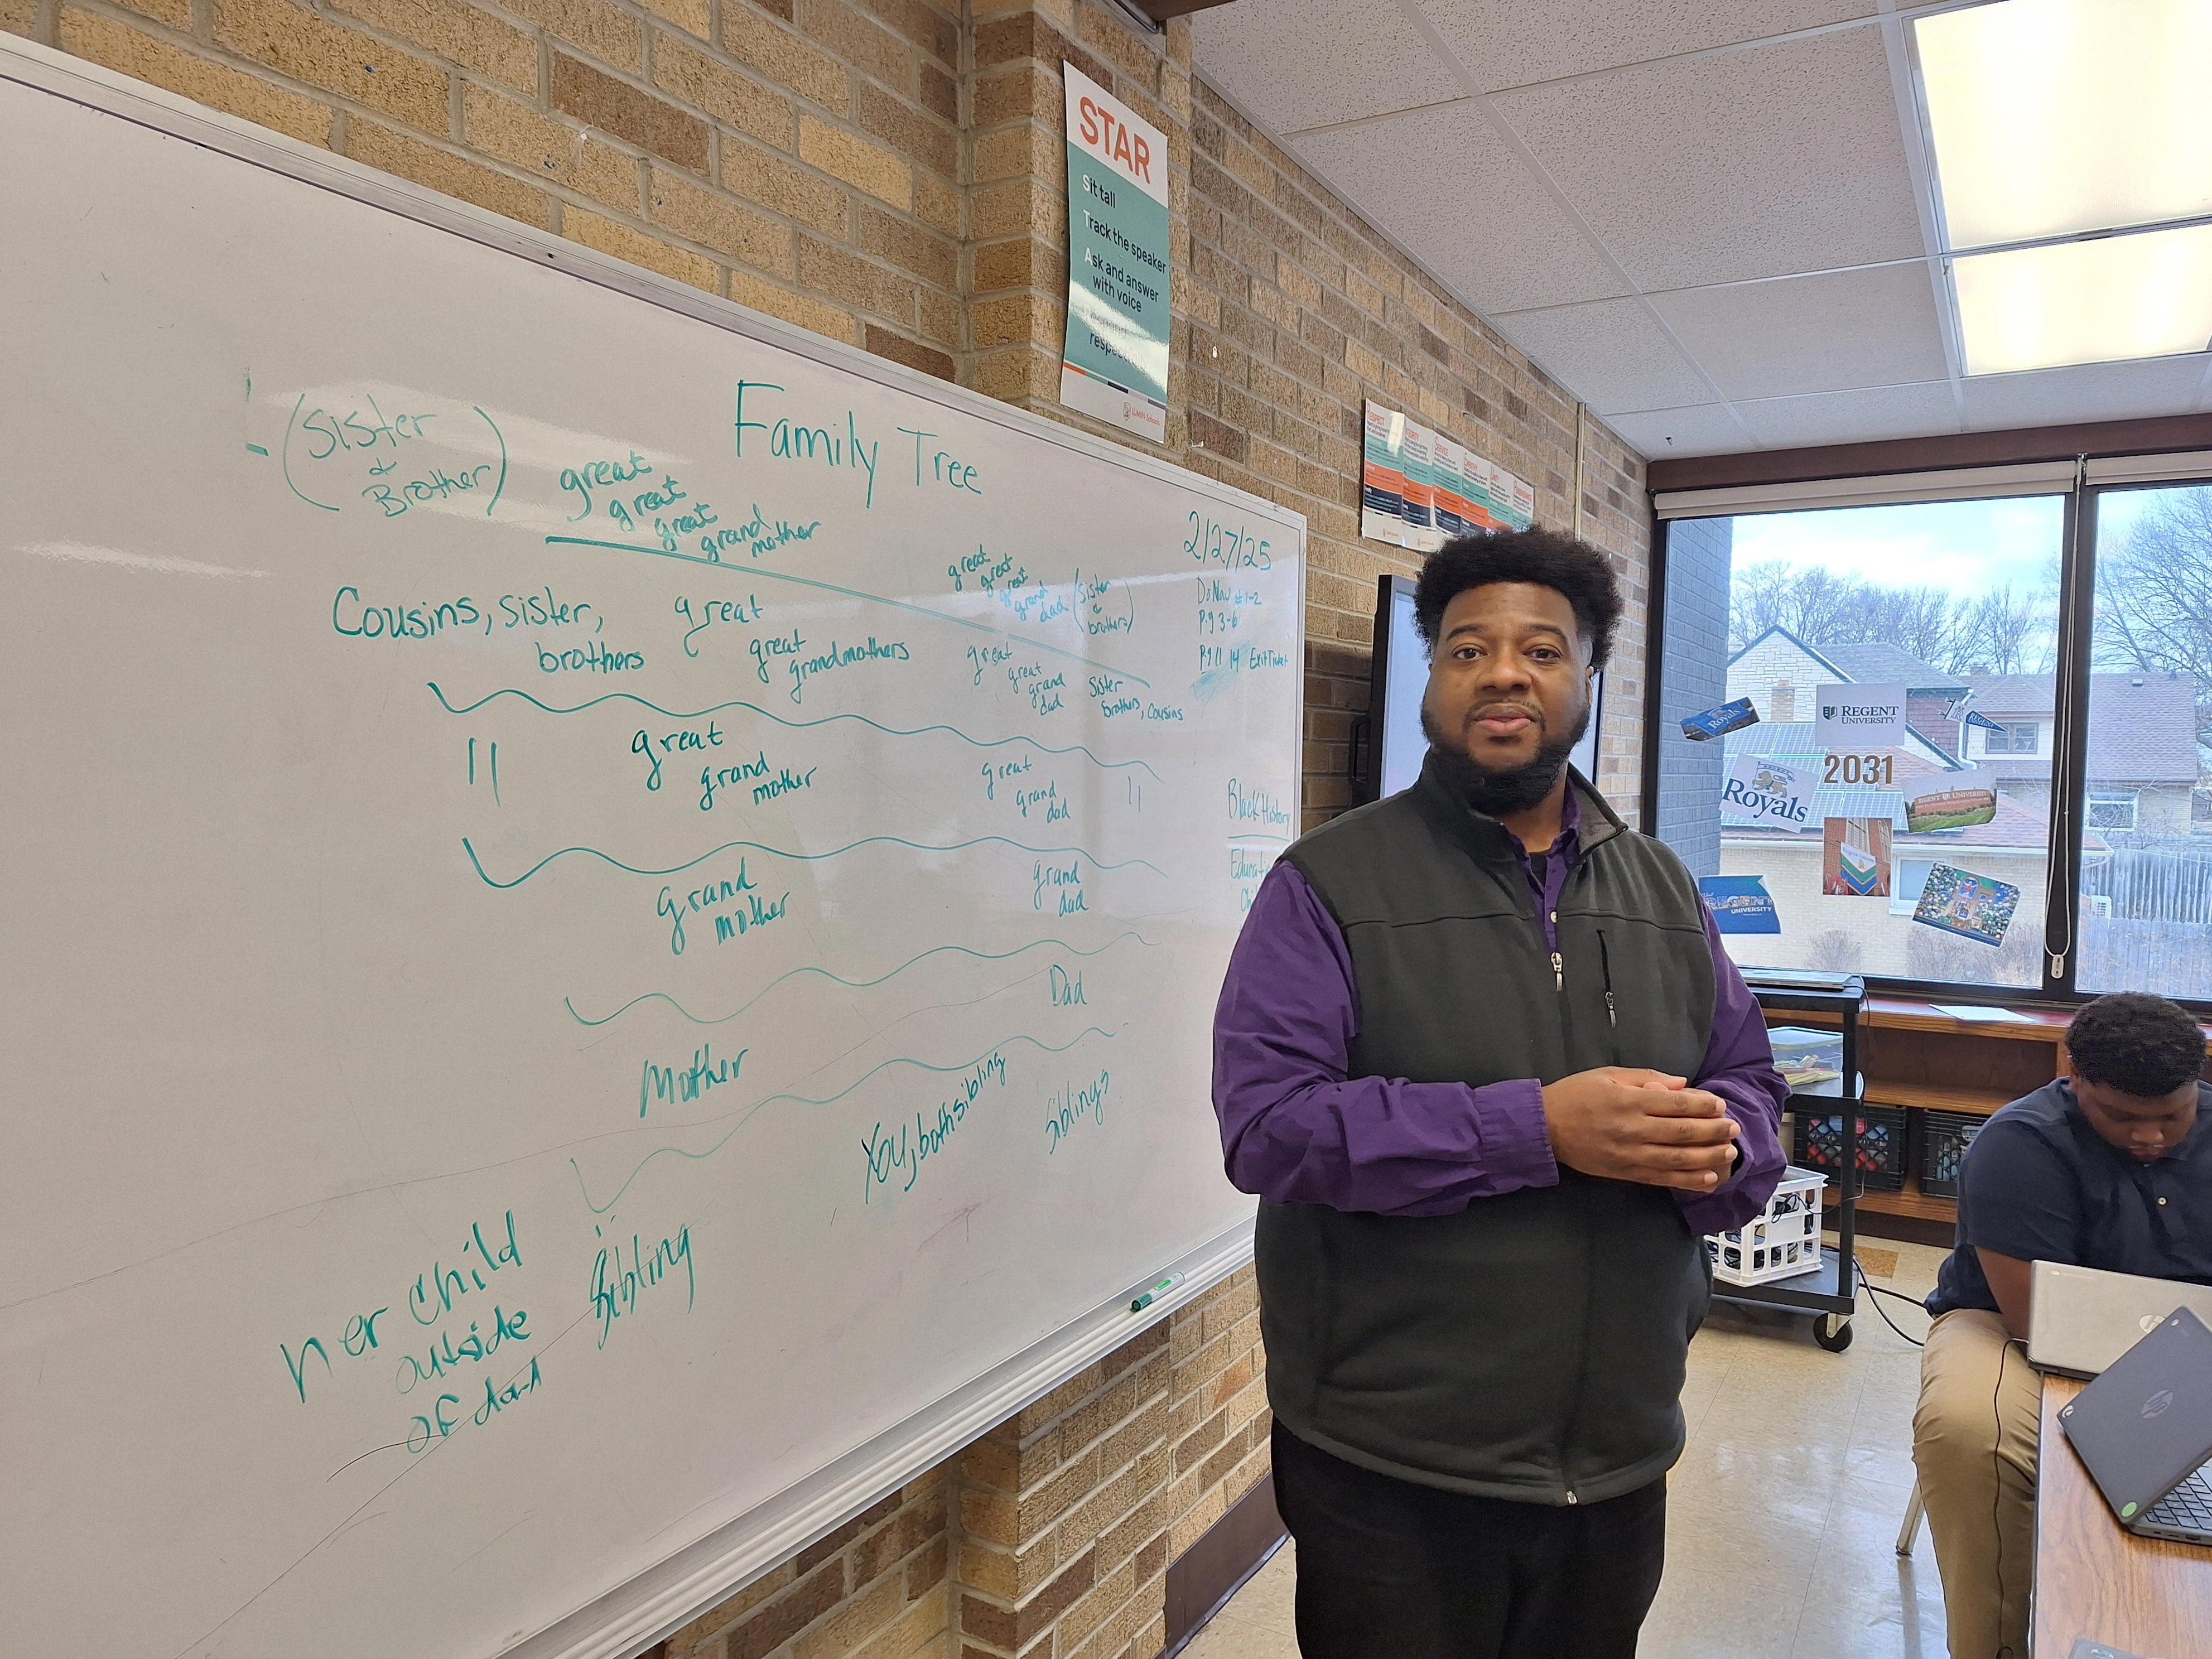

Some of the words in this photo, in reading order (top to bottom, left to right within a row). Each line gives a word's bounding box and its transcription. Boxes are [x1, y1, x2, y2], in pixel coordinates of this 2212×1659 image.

[1080, 97, 1150, 185] STAR
[1082, 174, 1097, 197] Sit
[1100, 183, 1116, 209] tall
[1083, 209, 1111, 241] Track
[1113, 230, 1130, 252] the
[1131, 242, 1166, 274] speaker
[1085, 247, 1104, 272] Ask
[1106, 262, 1124, 283] and
[1126, 275, 1159, 303] answer
[1092, 276, 1115, 299] with
[1116, 290, 1142, 312] voice
[734, 379, 879, 509] Family
[896, 426, 982, 496] Tree
[560, 451, 653, 522] great
[609, 474, 687, 532] great
[654, 502, 719, 552] great
[700, 503, 772, 563] grand
[751, 520, 822, 558] mother
[1183, 510, 1271, 573] 2/27/25
[948, 544, 990, 592] great
[981, 553, 1013, 598] great
[333, 586, 493, 639] Cousins,
[1014, 580, 1049, 621] grand
[1040, 595, 1069, 623] dad
[1218, 610, 1238, 633] 3-6
[674, 594, 763, 658] great
[534, 641, 645, 674] brothers
[749, 628, 807, 684] great
[788, 636, 910, 705] grandmothers
[967, 641, 1013, 687] great
[1008, 661, 1042, 695] great
[1028, 671, 1067, 709] grand
[1039, 692, 1064, 717] dad
[1841, 706, 1898, 716] REGENT
[1708, 708, 1741, 729] Royals
[632, 721, 725, 791] great
[981, 754, 1033, 800] great
[1824, 755, 1893, 784] 2031
[700, 751, 770, 811] grand
[753, 766, 817, 806] mother
[1015, 780, 1057, 818] grand
[1722, 778, 1808, 822] Royals
[1047, 798, 1071, 823] dad
[1228, 778, 1260, 822] Black
[1261, 791, 1290, 836] History
[656, 857, 758, 956] grand
[1033, 860, 1081, 910] grand
[1059, 890, 1089, 918] dad
[715, 893, 789, 946] mother
[1049, 964, 1087, 1006] Dad
[640, 1043, 749, 1118] Mother
[395, 1304, 532, 1395] outside
